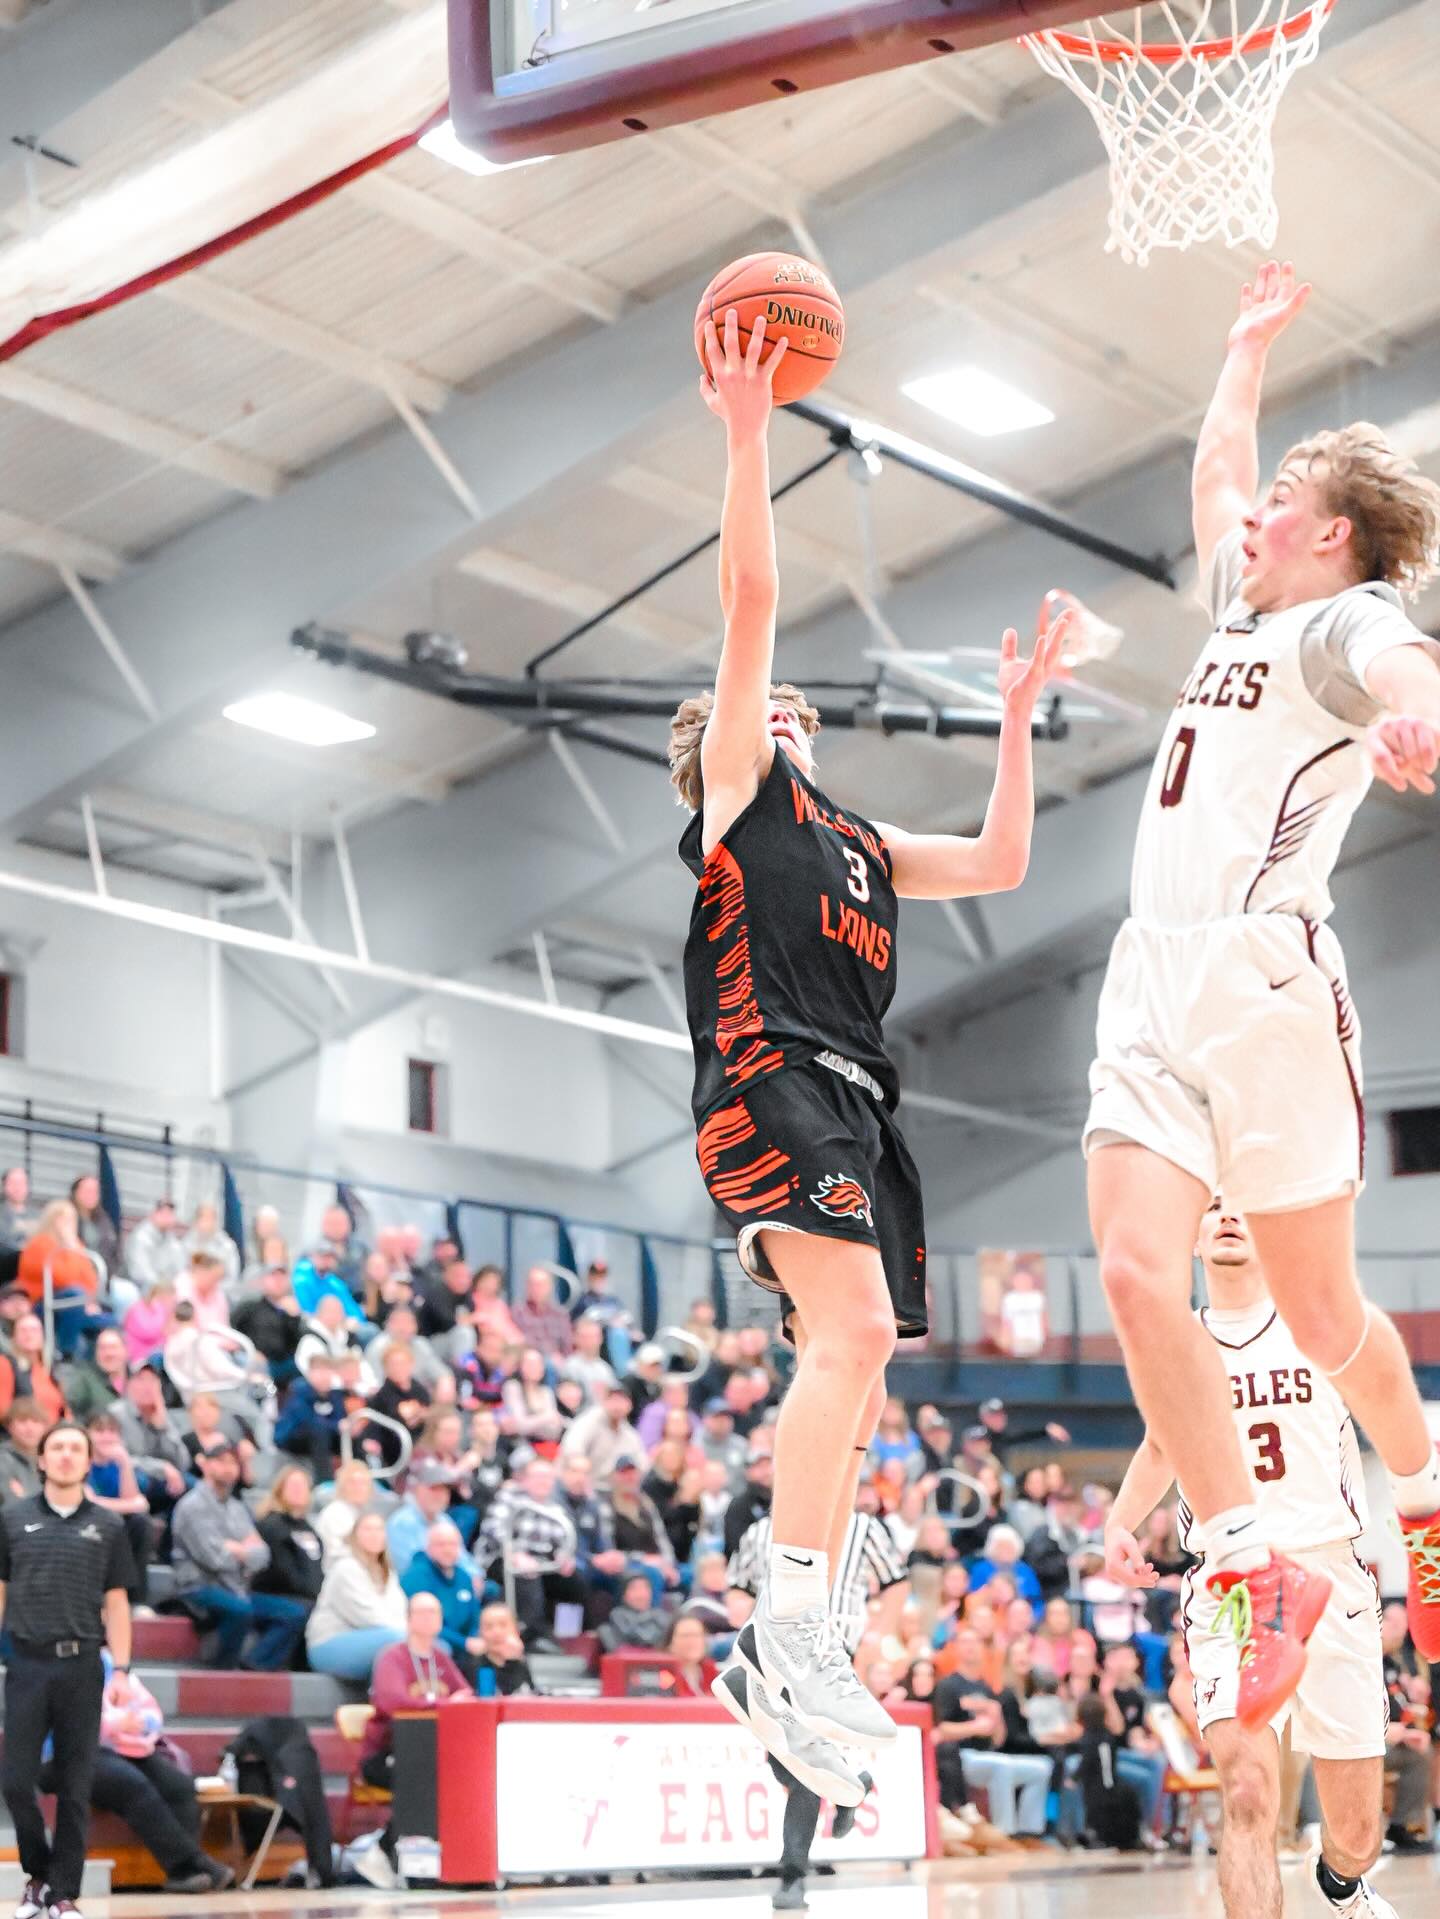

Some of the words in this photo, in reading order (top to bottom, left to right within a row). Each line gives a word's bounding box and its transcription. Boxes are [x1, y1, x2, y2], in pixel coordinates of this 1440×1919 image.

[767, 301, 842, 344] PALDING
[1160, 727, 1196, 808] 0
[843, 846, 870, 903] 3
[1229, 1368, 1313, 1409] GLES
[1248, 1422, 1286, 1482] 3
[660, 1783, 880, 1843] EAGS
